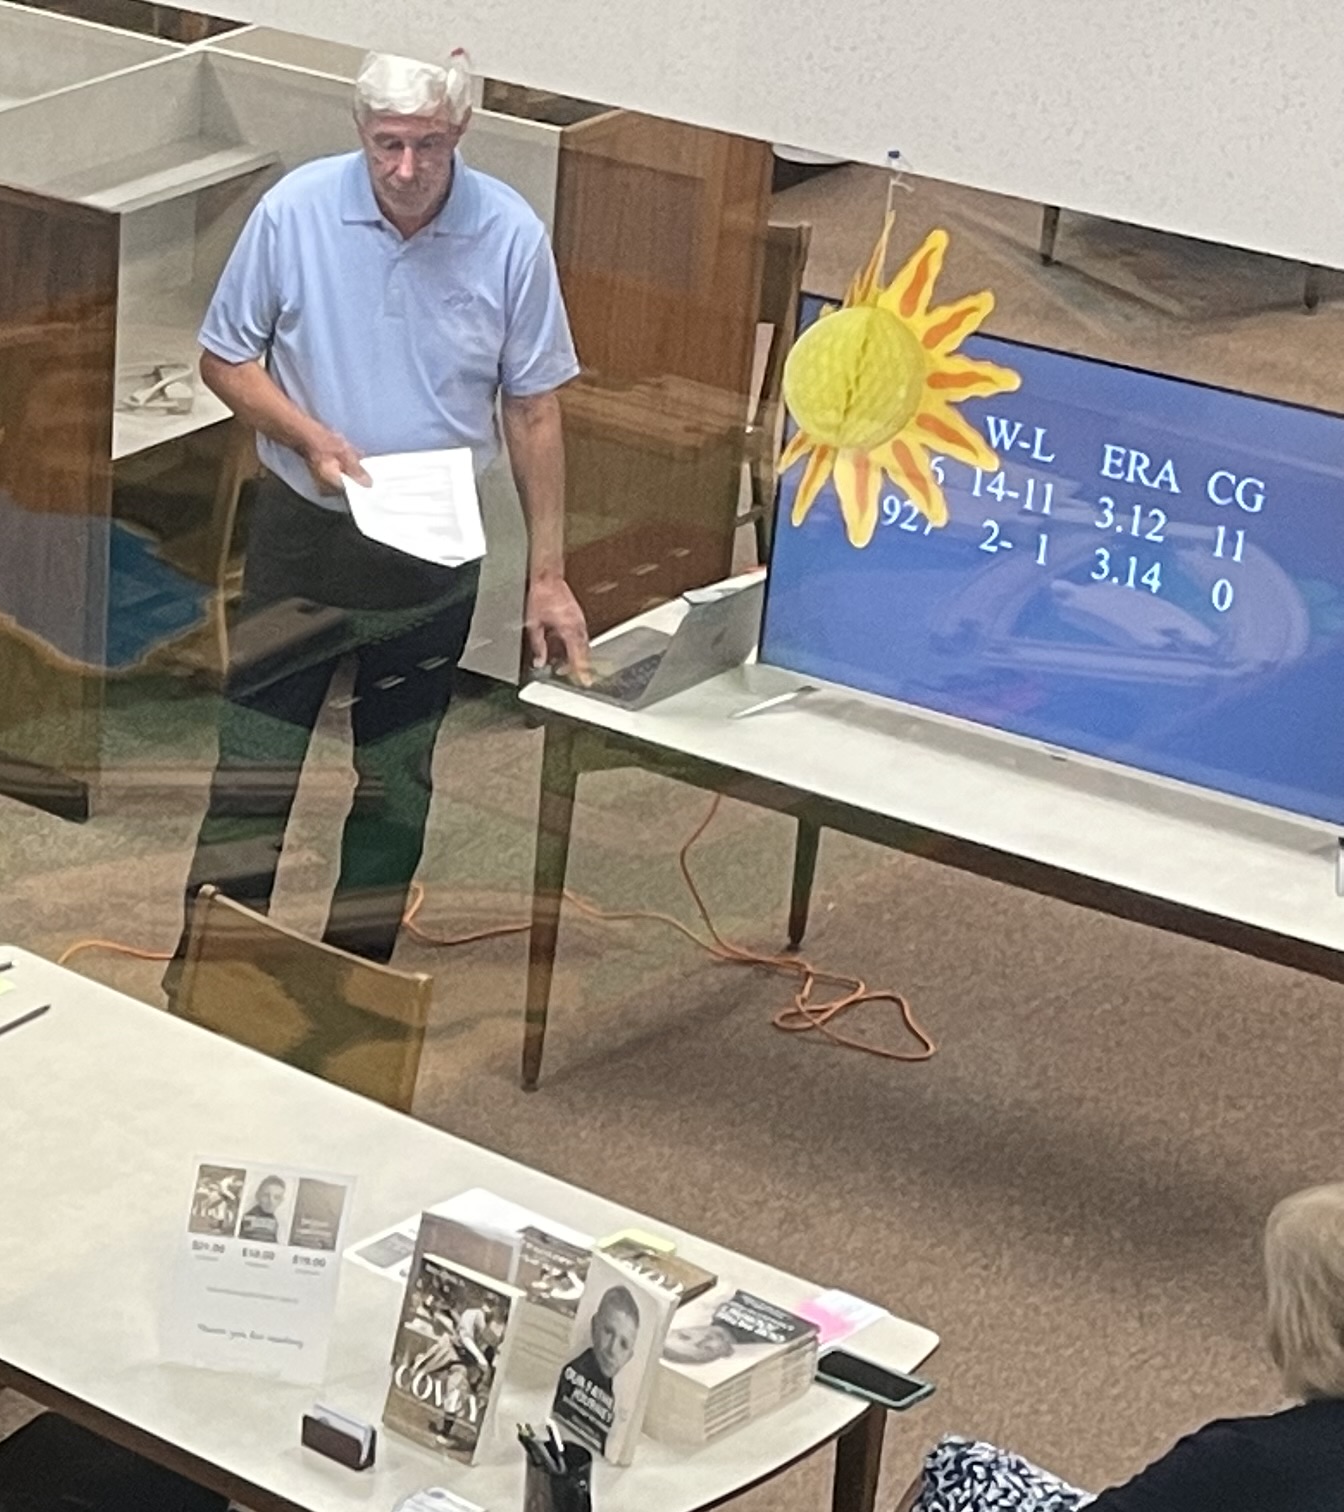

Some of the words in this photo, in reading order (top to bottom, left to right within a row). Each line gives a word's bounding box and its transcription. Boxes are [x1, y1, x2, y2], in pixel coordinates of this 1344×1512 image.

[985, 415, 1056, 463] W-L
[1100, 443, 1181, 494] ERA
[1207, 469, 1267, 514] CG
[972, 466, 1054, 516] 14-11
[1094, 495, 1168, 543] 3.12
[1214, 525, 1246, 563] 11
[1090, 547, 1163, 594] 3.14
[1211, 577, 1234, 612] 0
